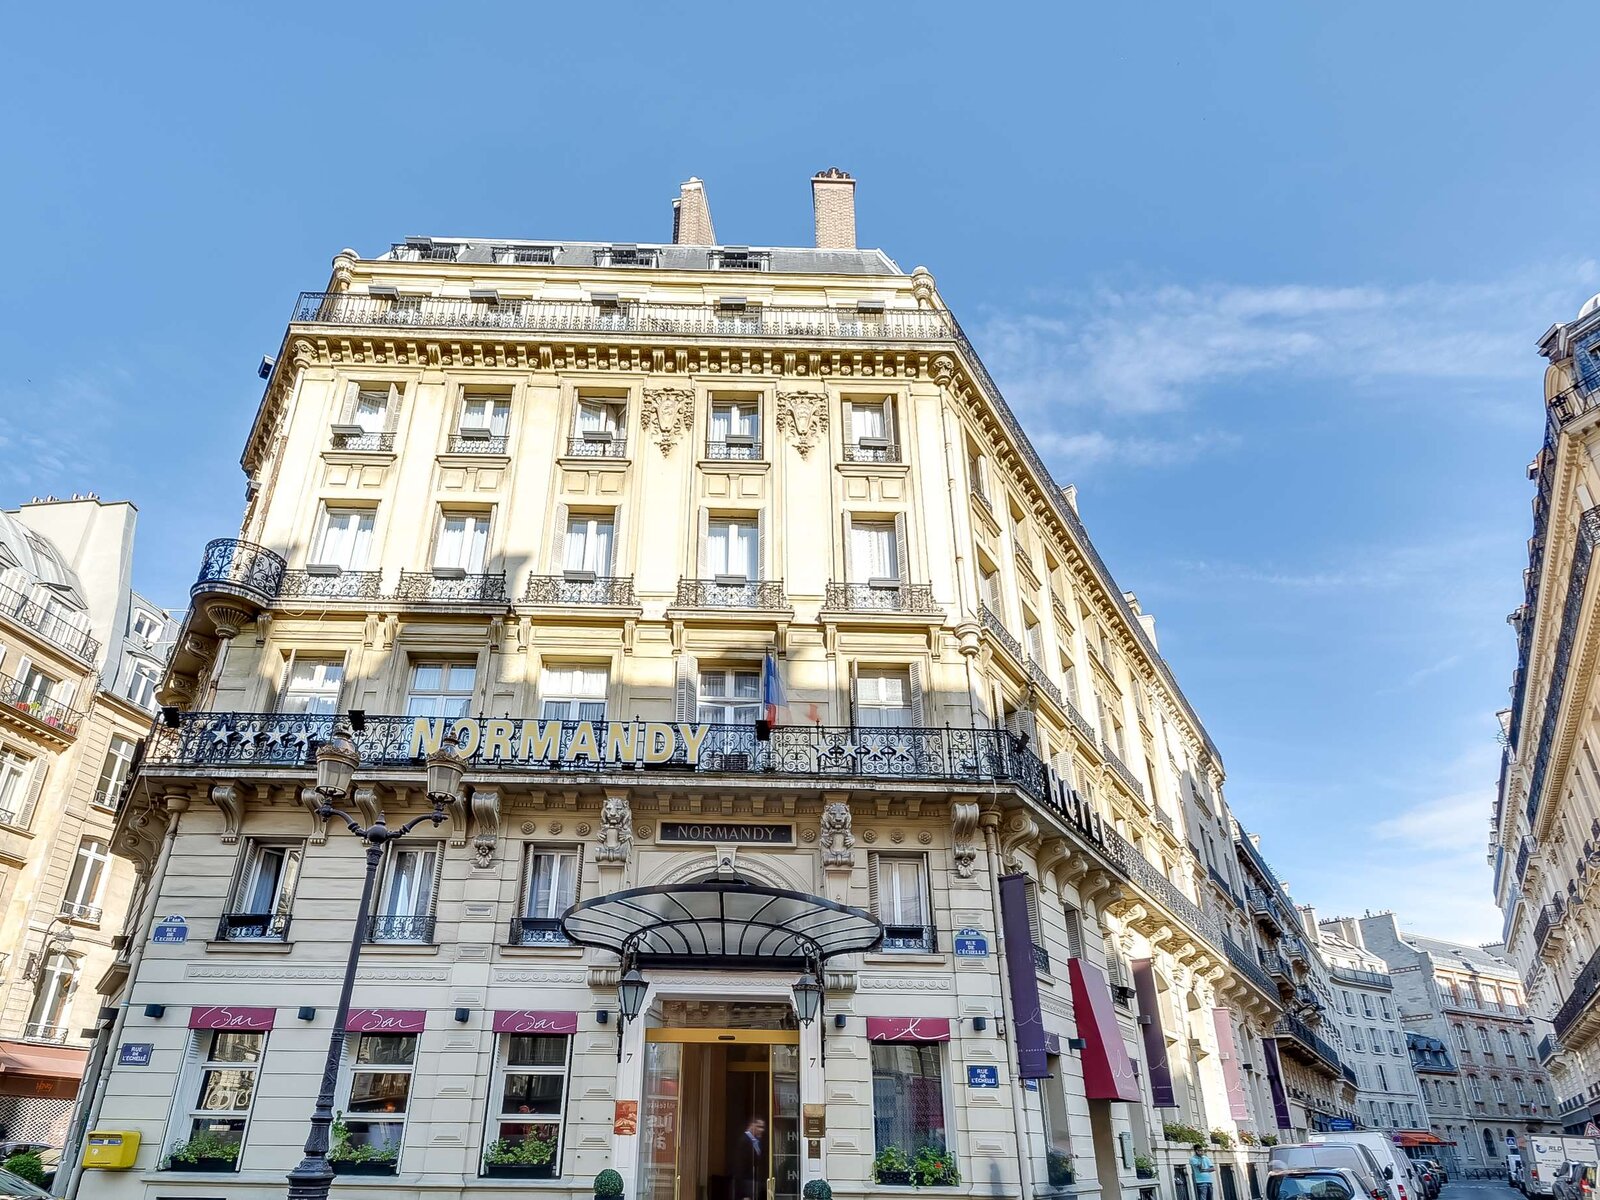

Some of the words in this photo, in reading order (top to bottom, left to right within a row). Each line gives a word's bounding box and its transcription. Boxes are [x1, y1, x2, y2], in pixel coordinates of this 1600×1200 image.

[407, 716, 710, 765] NORMANDY
[1045, 762, 1110, 853] HOTEL
[676, 825, 776, 840] NORMANDY
[197, 1006, 273, 1029] Bar
[348, 1009, 425, 1031] Bar
[501, 1010, 576, 1032] Bar
[626, 1053, 633, 1064] 7
[809, 1057, 817, 1068] 7
